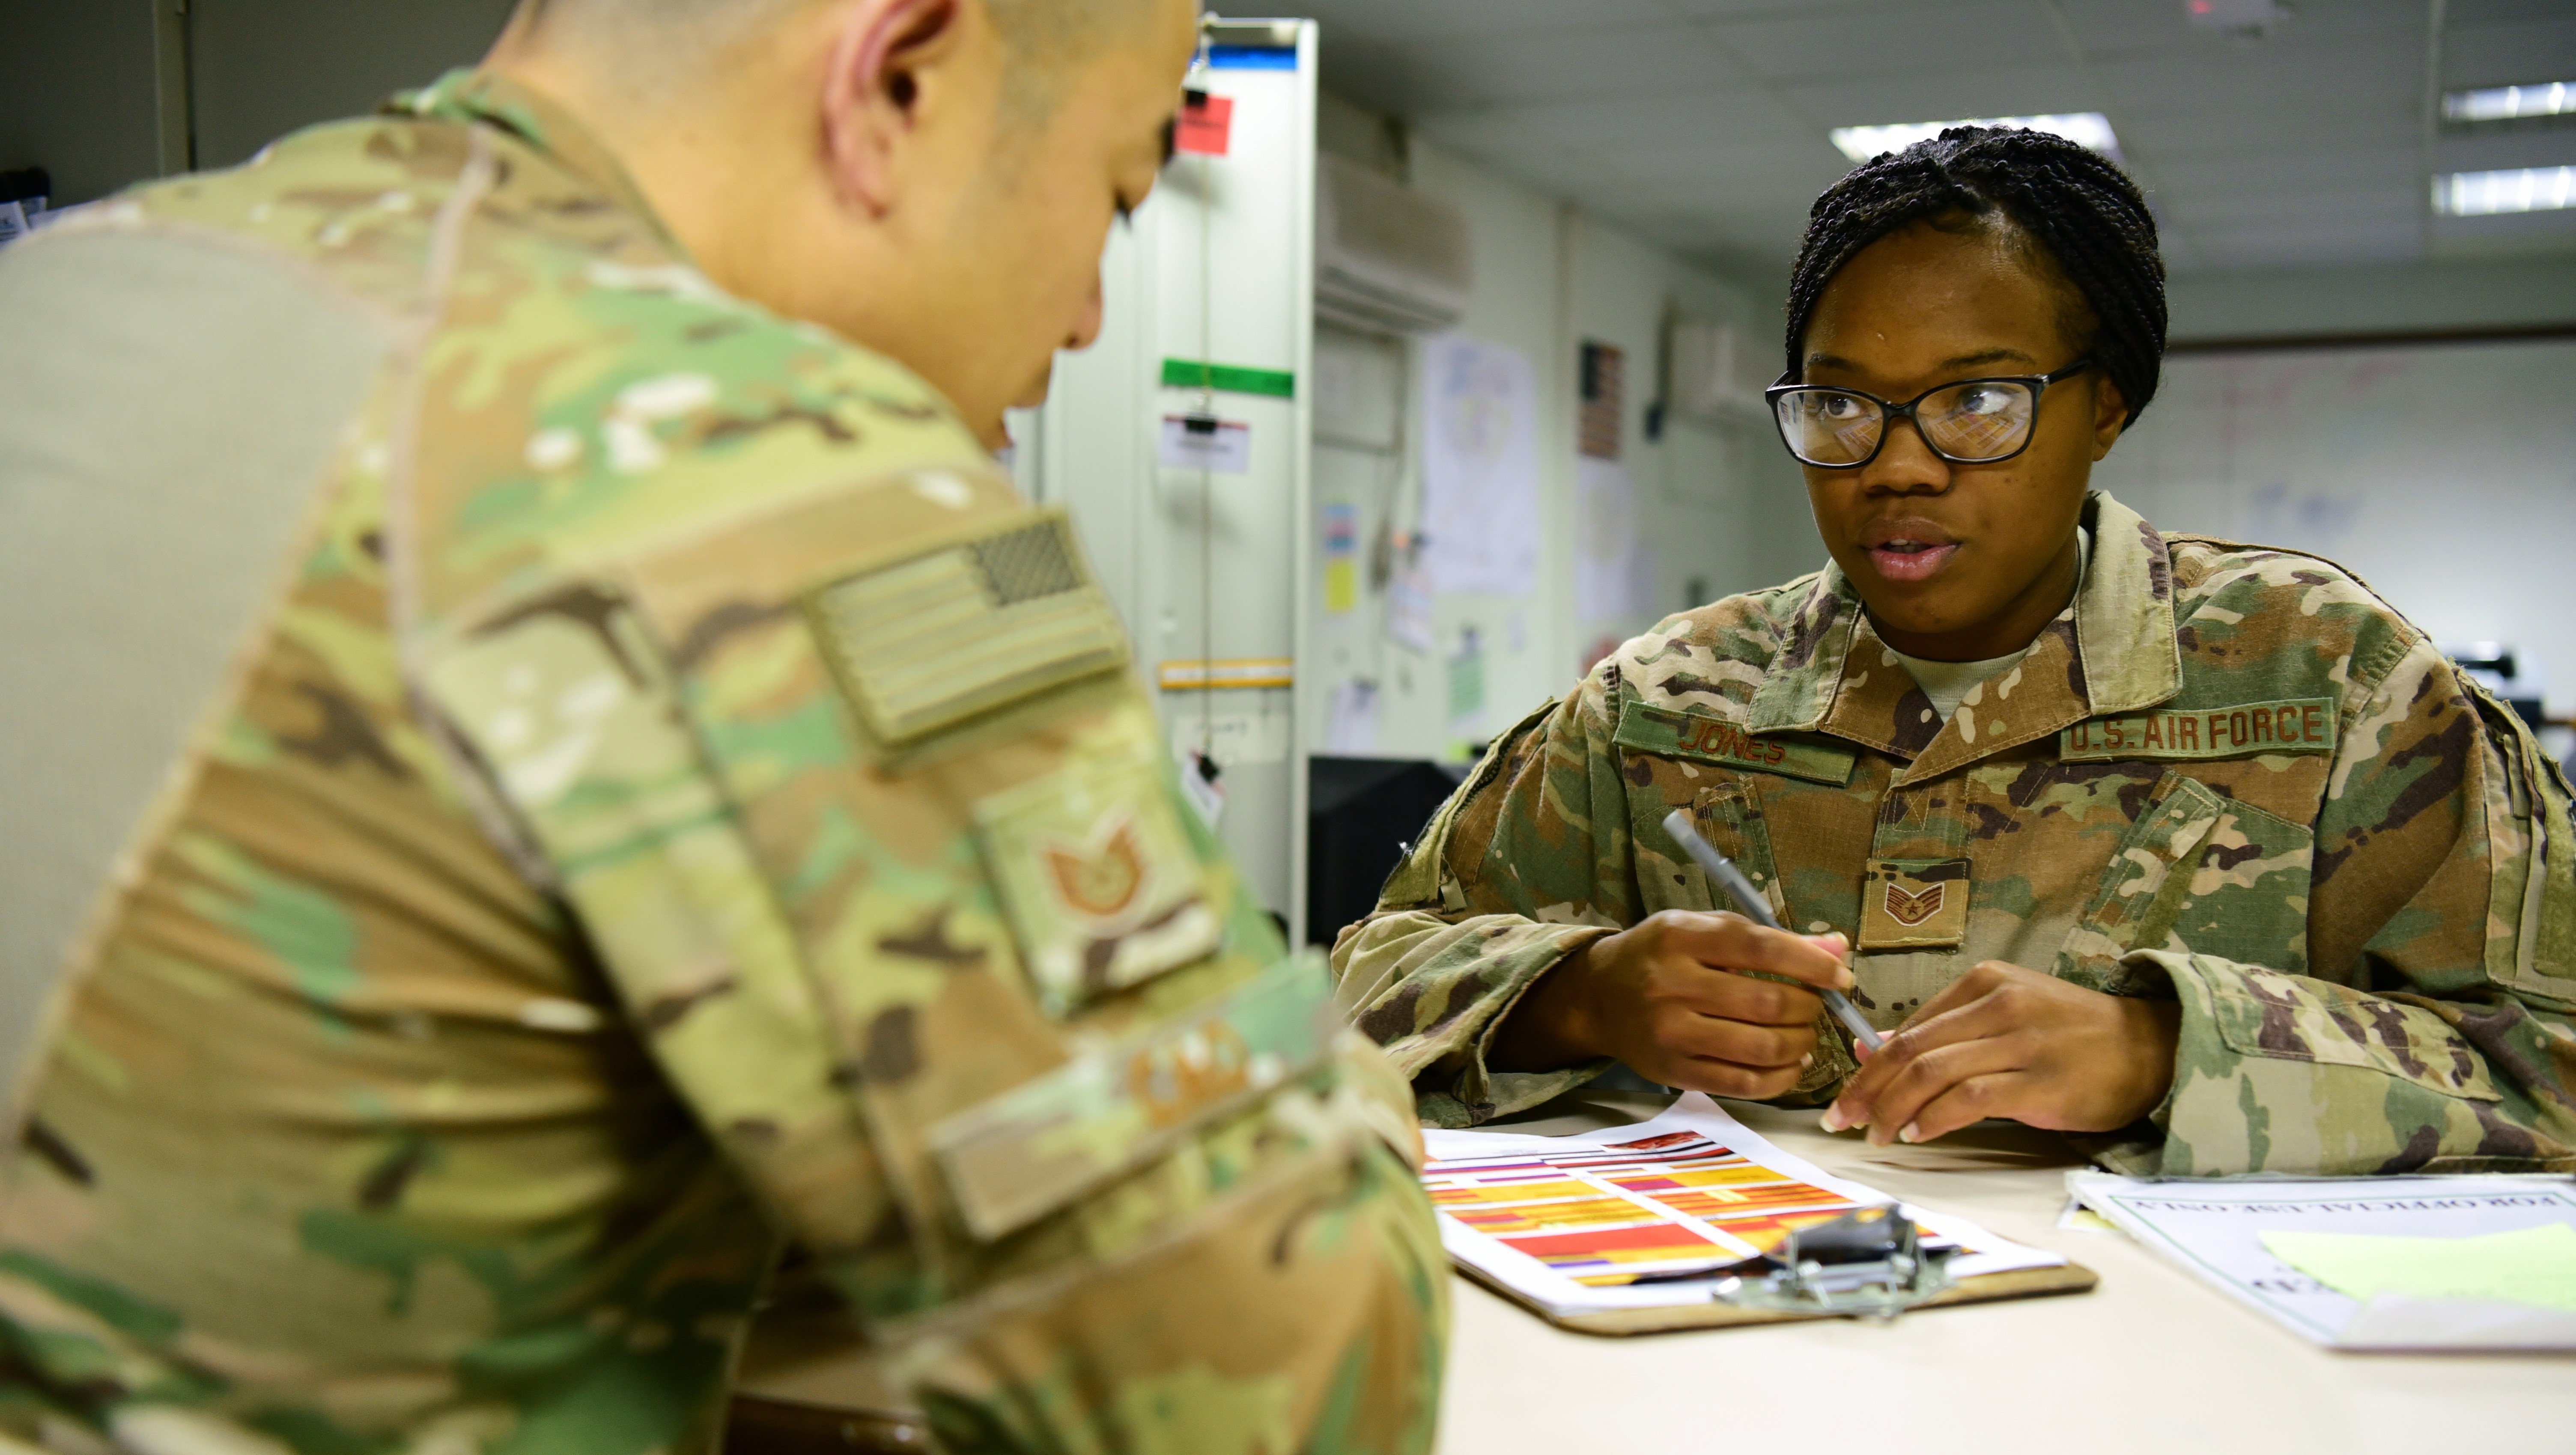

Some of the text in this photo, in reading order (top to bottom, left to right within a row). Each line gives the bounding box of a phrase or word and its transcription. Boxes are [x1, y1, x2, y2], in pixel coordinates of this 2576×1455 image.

[1678, 722, 1789, 765] JONES
[2070, 705, 2323, 751] U.S. AIR FORCE
[2135, 1197, 2558, 1213] FOR OFFICIAL USE ONLY
